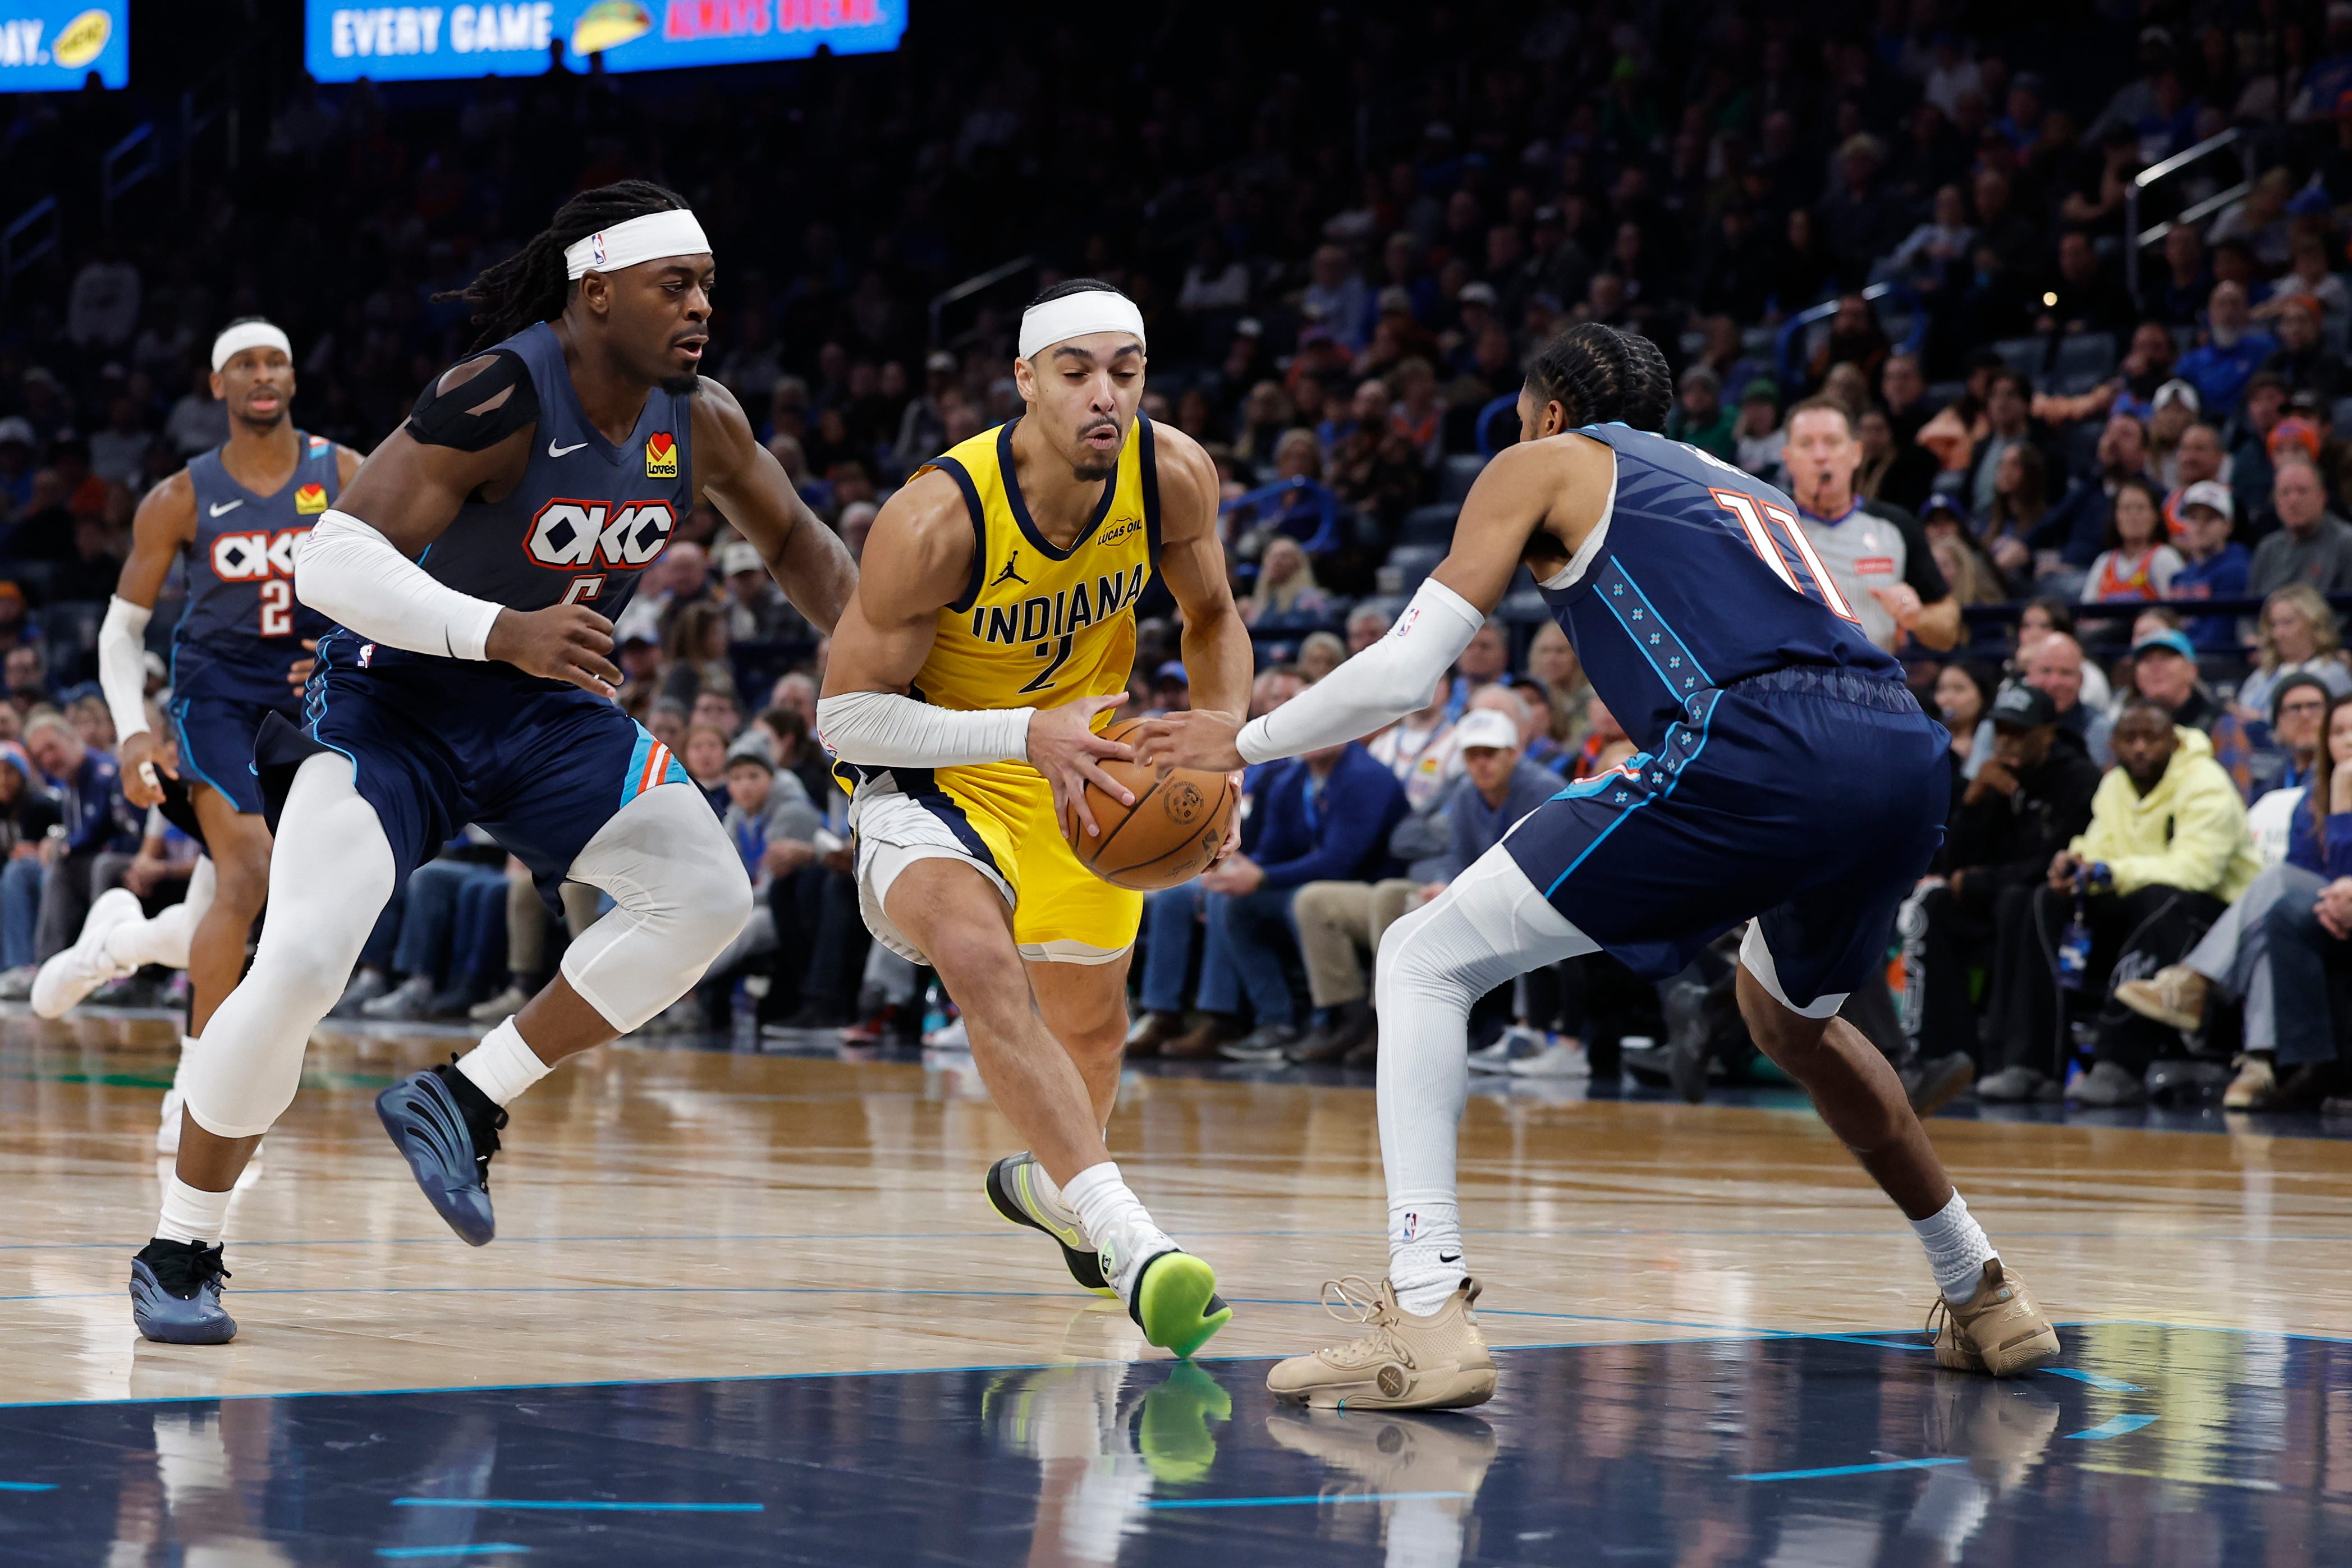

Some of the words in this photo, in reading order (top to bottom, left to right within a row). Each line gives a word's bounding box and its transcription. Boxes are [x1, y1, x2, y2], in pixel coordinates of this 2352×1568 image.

[0, 19, 50, 67] AY.
[332, 6, 443, 57] EVERY
[450, 2, 553, 53] GAME
[522, 497, 677, 570] OKC
[1097, 525, 1125, 545] LUCAS
[1127, 520, 1142, 533] OIL
[1708, 487, 1862, 624] 11
[260, 579, 293, 638] 2
[972, 561, 1144, 645] INDIANA
[1016, 633, 1075, 695] 2
